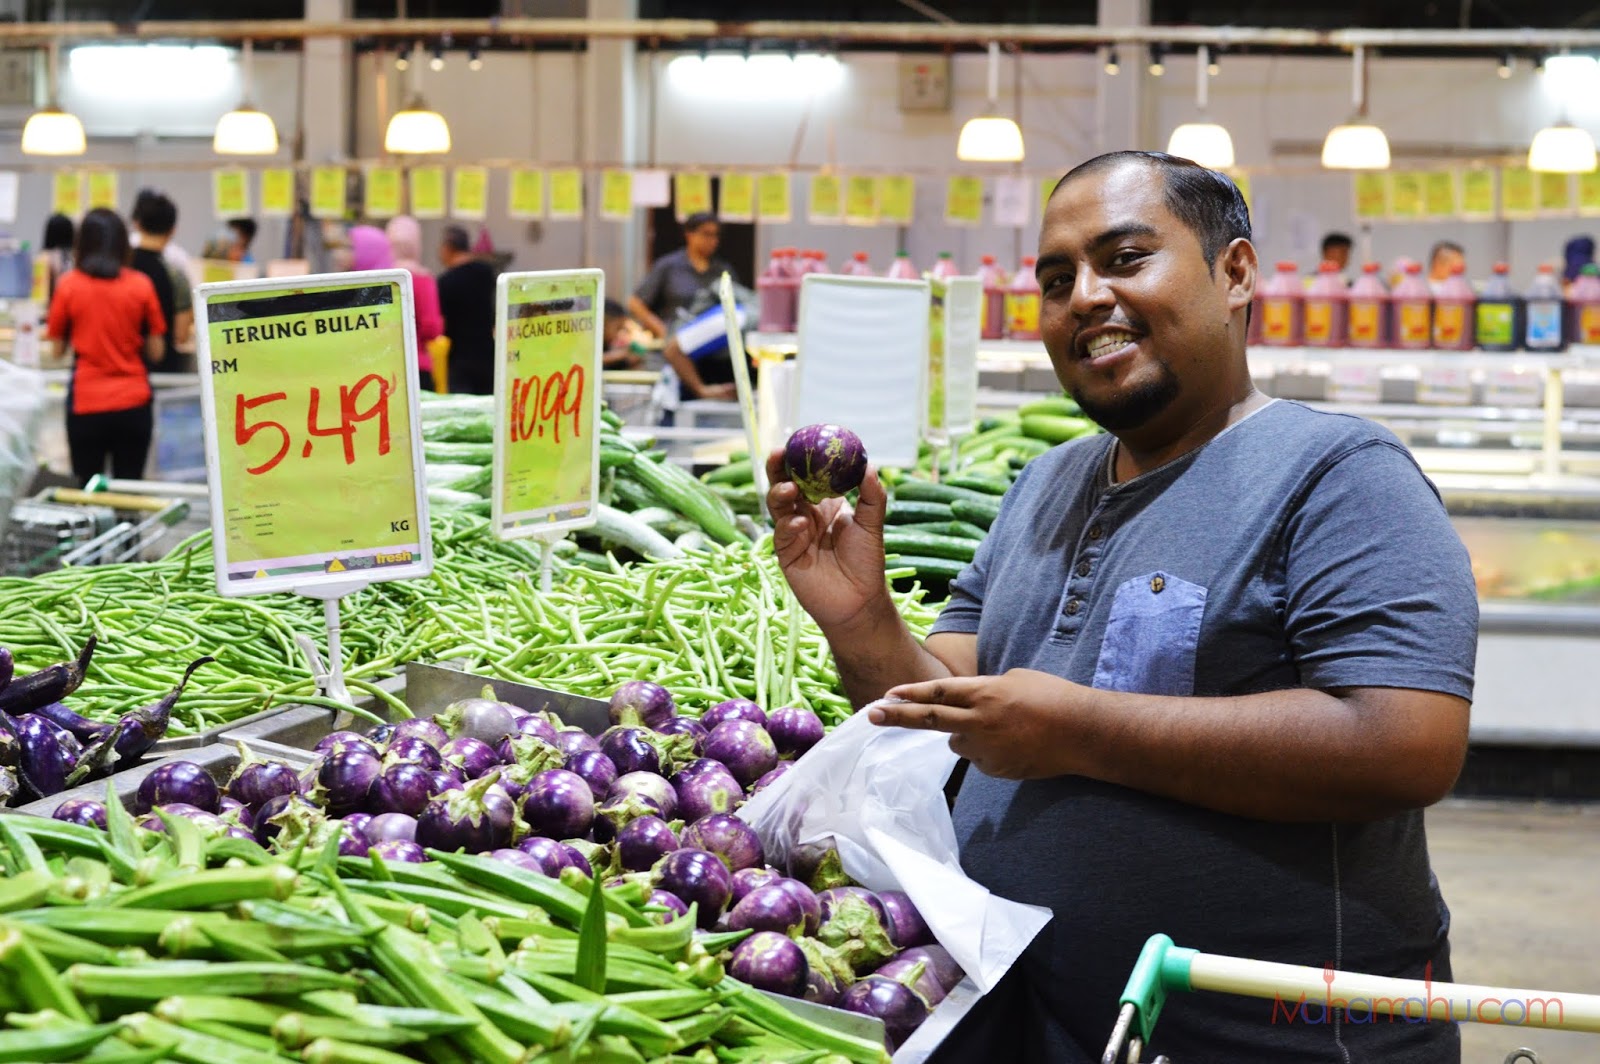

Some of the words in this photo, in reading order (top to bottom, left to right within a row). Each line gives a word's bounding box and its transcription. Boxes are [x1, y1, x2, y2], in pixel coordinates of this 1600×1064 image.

[222, 320, 307, 345] TERUNG
[315, 312, 381, 335] BULAT
[507, 321, 552, 340] KACANG
[556, 316, 593, 335] BUNCIS
[211, 358, 238, 375] RM
[511, 363, 585, 444] 10.99
[235, 373, 392, 475] 5.49
[391, 519, 410, 533] KG
[376, 549, 412, 565] fresh
